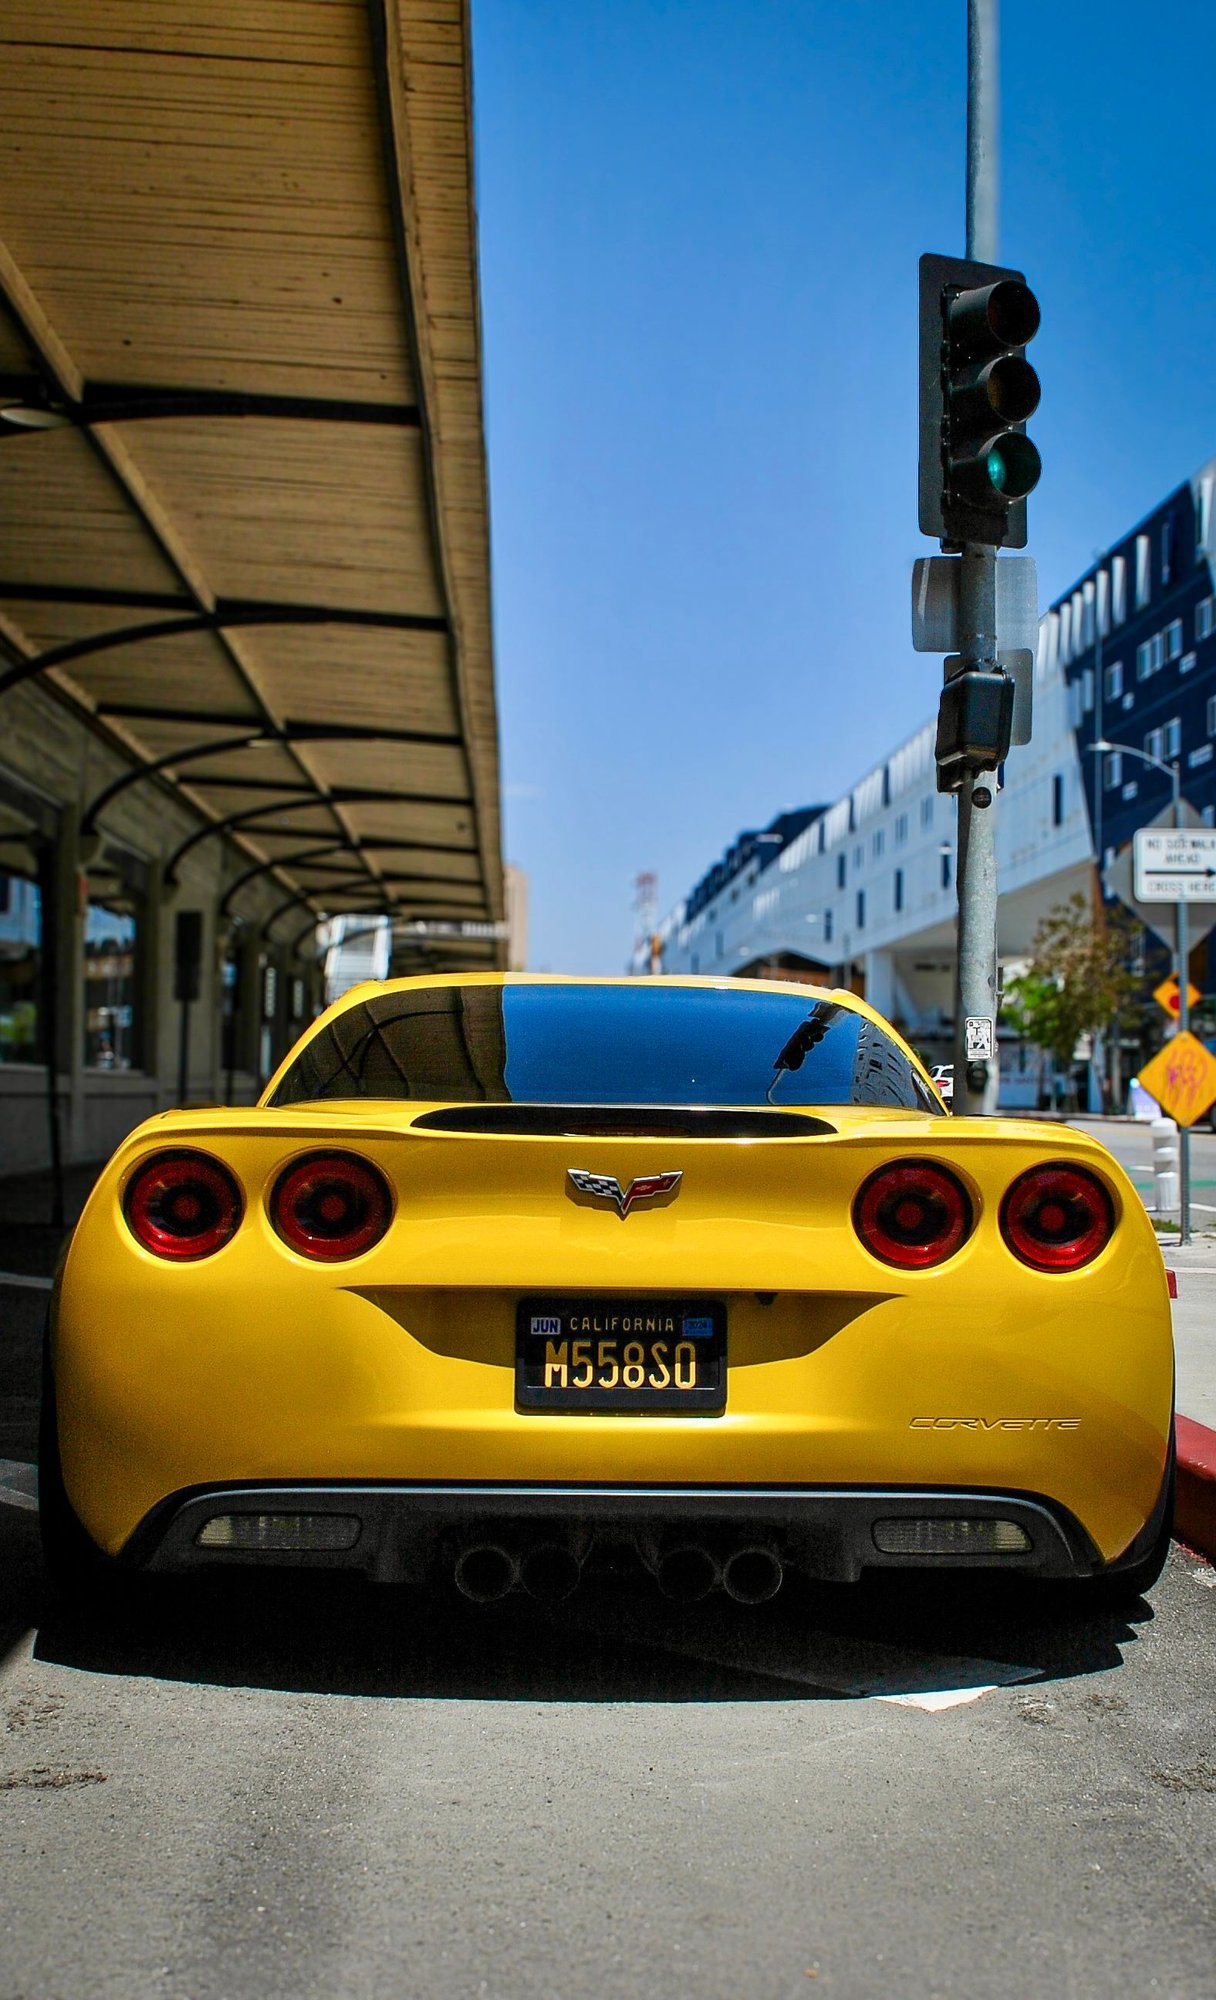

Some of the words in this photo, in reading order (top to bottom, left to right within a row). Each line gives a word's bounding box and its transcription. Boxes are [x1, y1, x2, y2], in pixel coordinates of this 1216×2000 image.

[532, 1318, 558, 1333] JUN
[570, 1317, 674, 1332] CALIFORNIA
[909, 1416, 1082, 1431] CORVETTE
